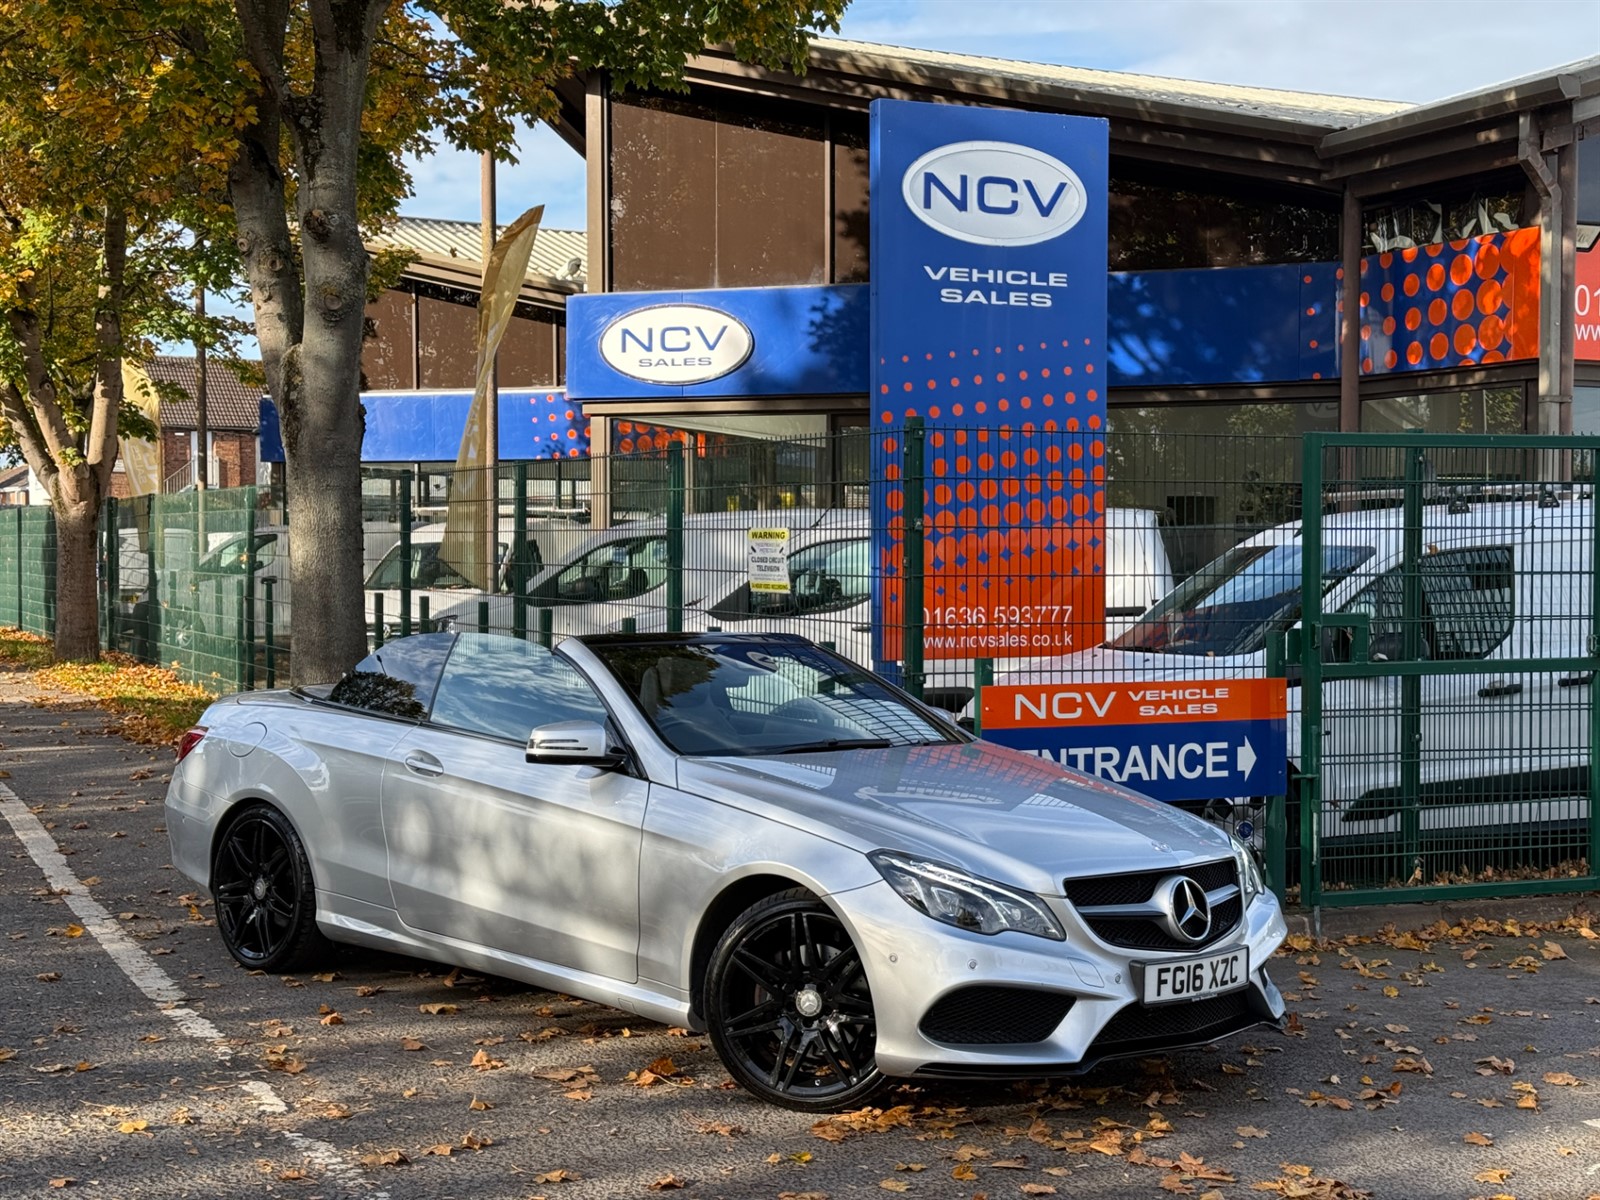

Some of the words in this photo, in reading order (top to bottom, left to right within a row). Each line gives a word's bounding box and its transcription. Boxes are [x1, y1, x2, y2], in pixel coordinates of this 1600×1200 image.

[923, 171, 1068, 218] NCV
[923, 265, 1068, 287] VEHICLE
[940, 288, 1053, 308] SALES
[621, 325, 728, 353] NCV
[638, 357, 712, 367] SALES
[751, 531, 786, 539] WARNING
[994, 605, 1073, 628] 593777
[923, 632, 1073, 649] www.ncvsales.co.uk
[1014, 691, 1116, 720] NCV
[1128, 688, 1229, 701] VEHICLE
[1139, 703, 1218, 716] SALES
[1157, 963, 1204, 997] FG16
[1209, 956, 1239, 989] XZC
